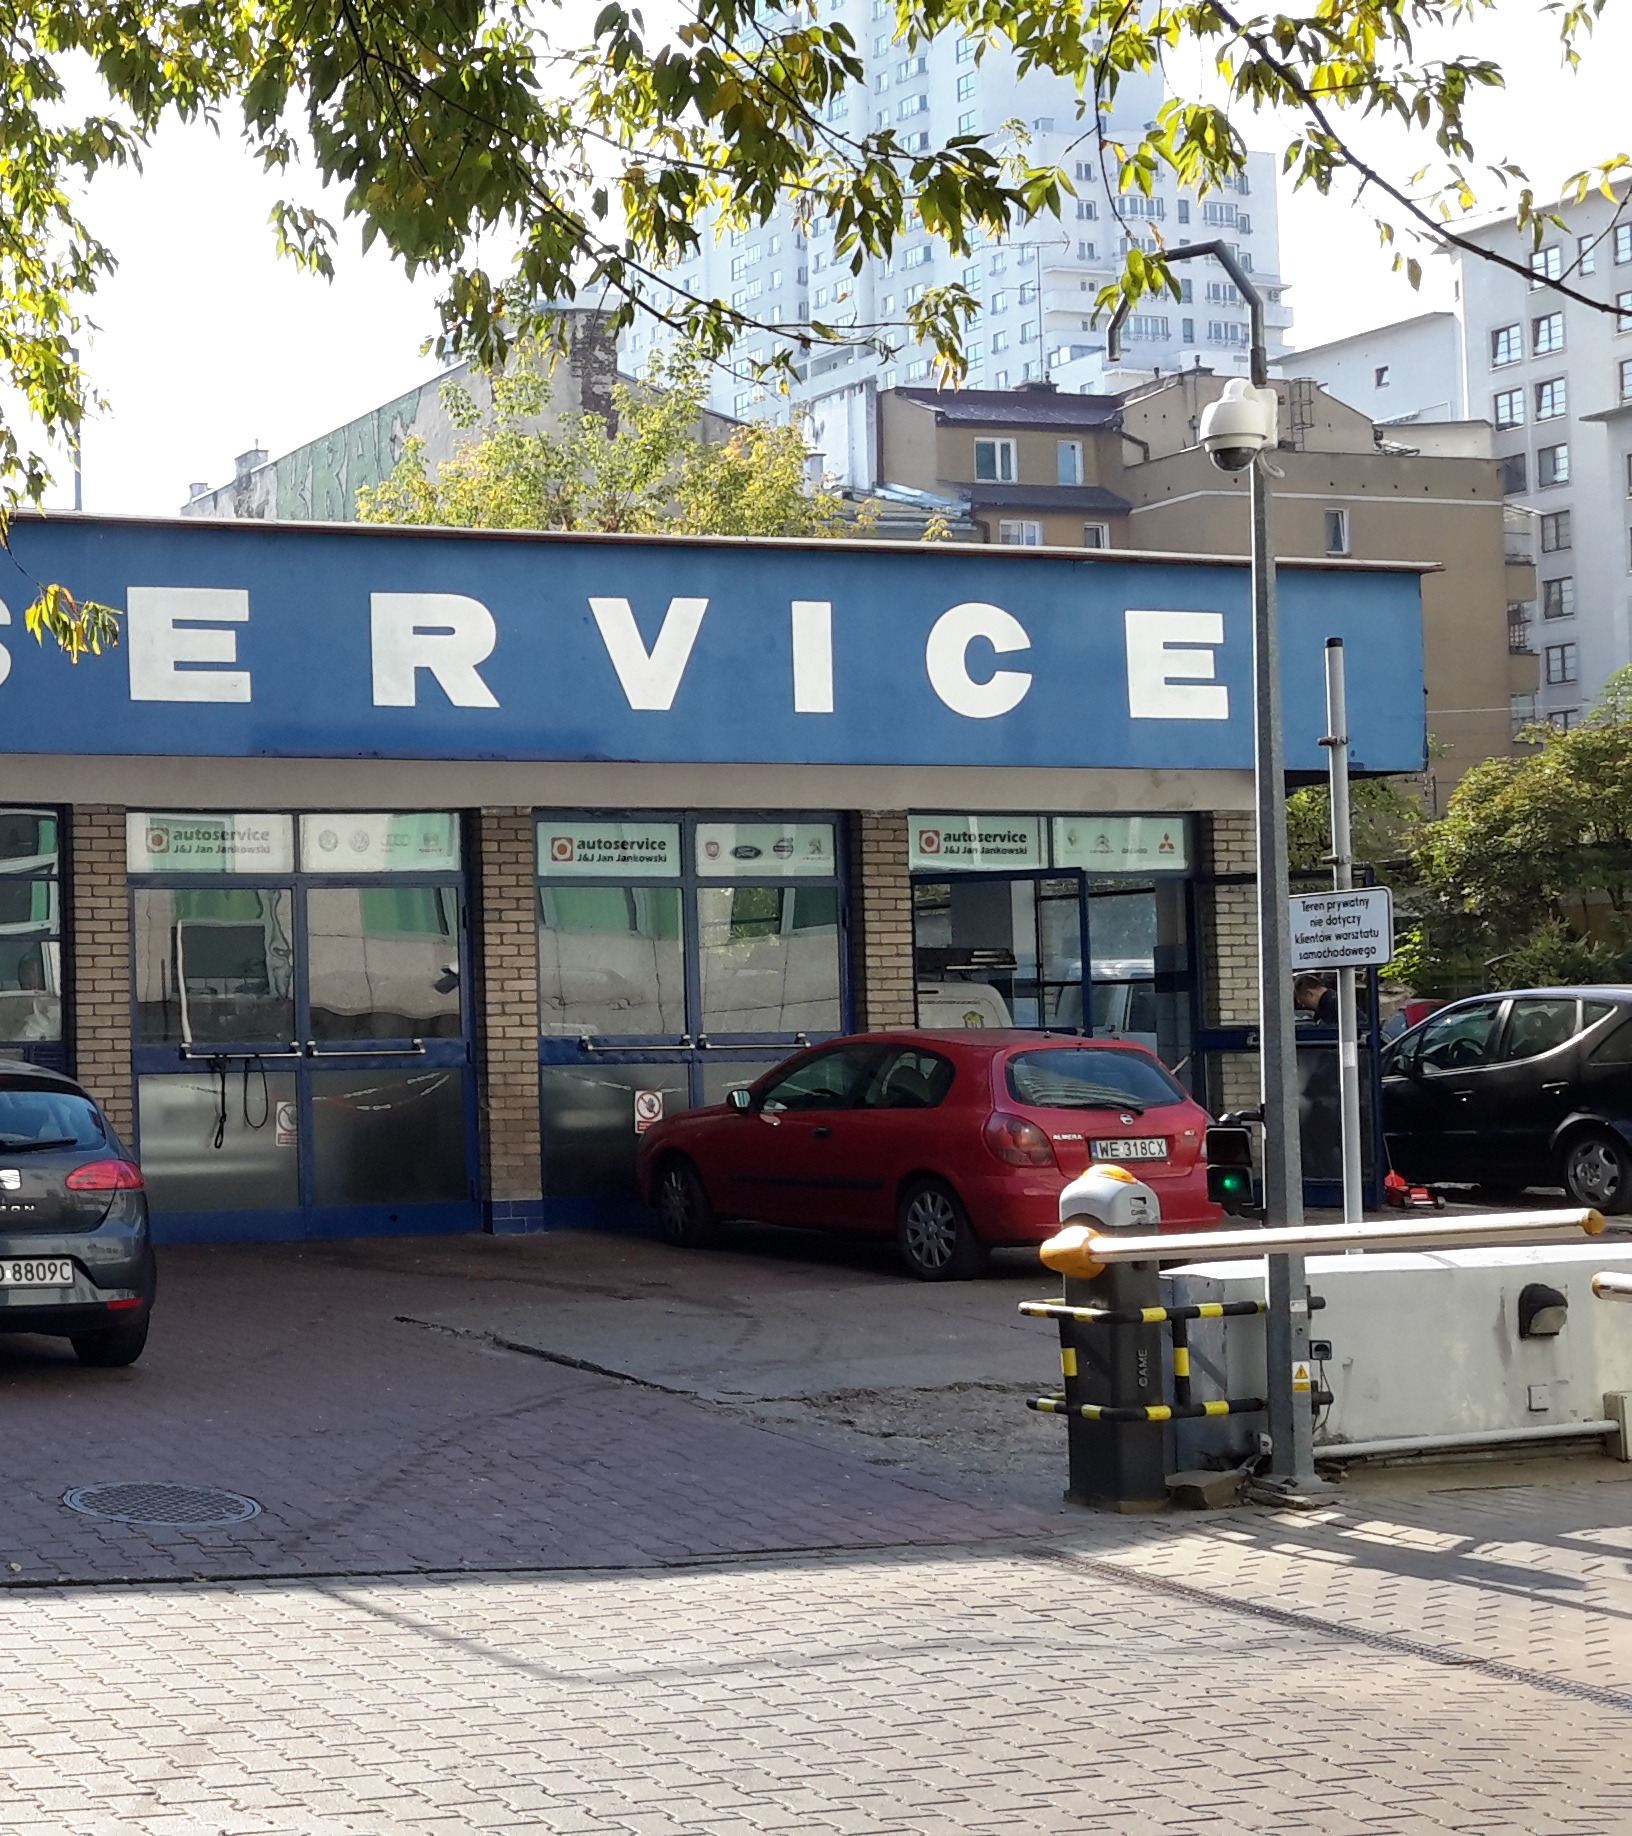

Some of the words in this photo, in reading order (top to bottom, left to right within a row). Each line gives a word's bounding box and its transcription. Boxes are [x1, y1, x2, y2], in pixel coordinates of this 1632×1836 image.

[173, 827, 270, 841] autoservice
[943, 830, 1027, 844] autoservice
[576, 837, 667, 851] autoservice
[597, 854, 614, 862] Jan
[1301, 901, 1325, 912] Teren
[1327, 896, 1370, 912] prywatny
[1310, 916, 1323, 926] nie
[1326, 914, 1362, 928] dotyczy
[1294, 930, 1332, 944] klientów
[1335, 928, 1380, 940] warsztatu
[1299, 945, 1377, 960] samochodowego
[1098, 1142, 1120, 1158] WE
[1123, 1140, 1166, 1157] 318CX
[11, 1261, 71, 1281] 8809C
